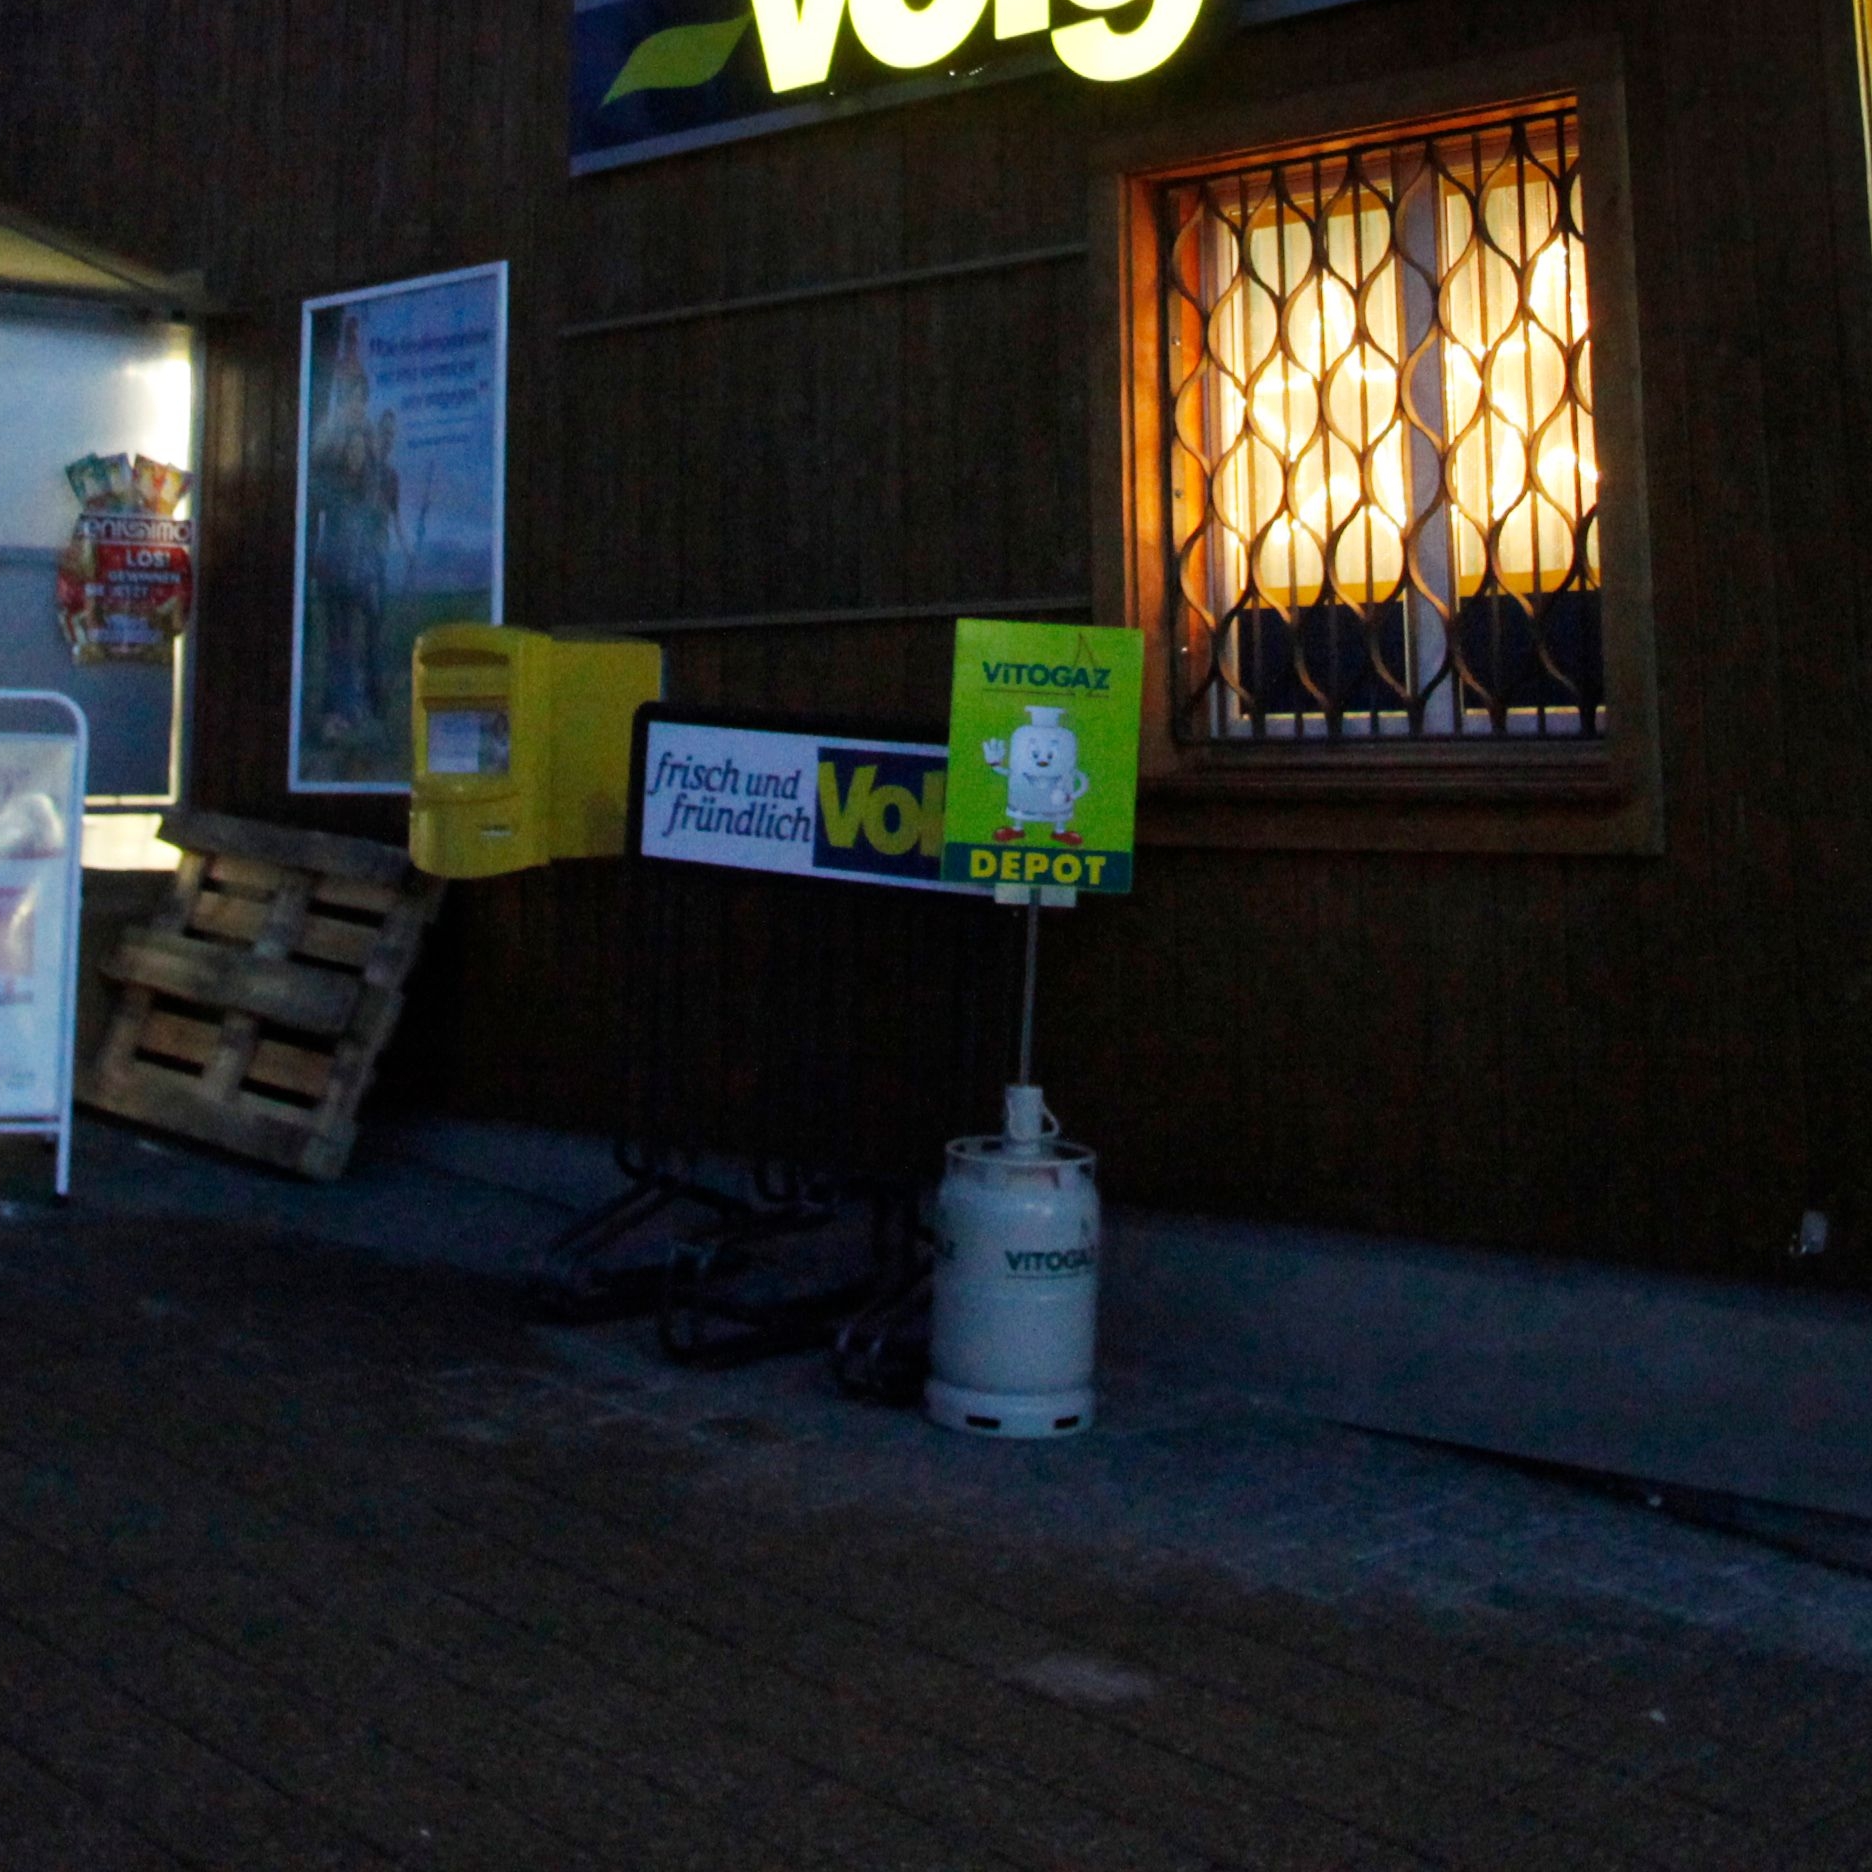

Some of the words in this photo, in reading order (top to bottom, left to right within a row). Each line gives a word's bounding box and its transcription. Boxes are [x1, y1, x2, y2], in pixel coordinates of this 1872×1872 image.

[651, 752, 739, 795] frisch
[746, 768, 800, 800] und
[663, 794, 812, 845] fründlich
[818, 760, 947, 860] Vol
[969, 848, 1107, 885] DEPOT
